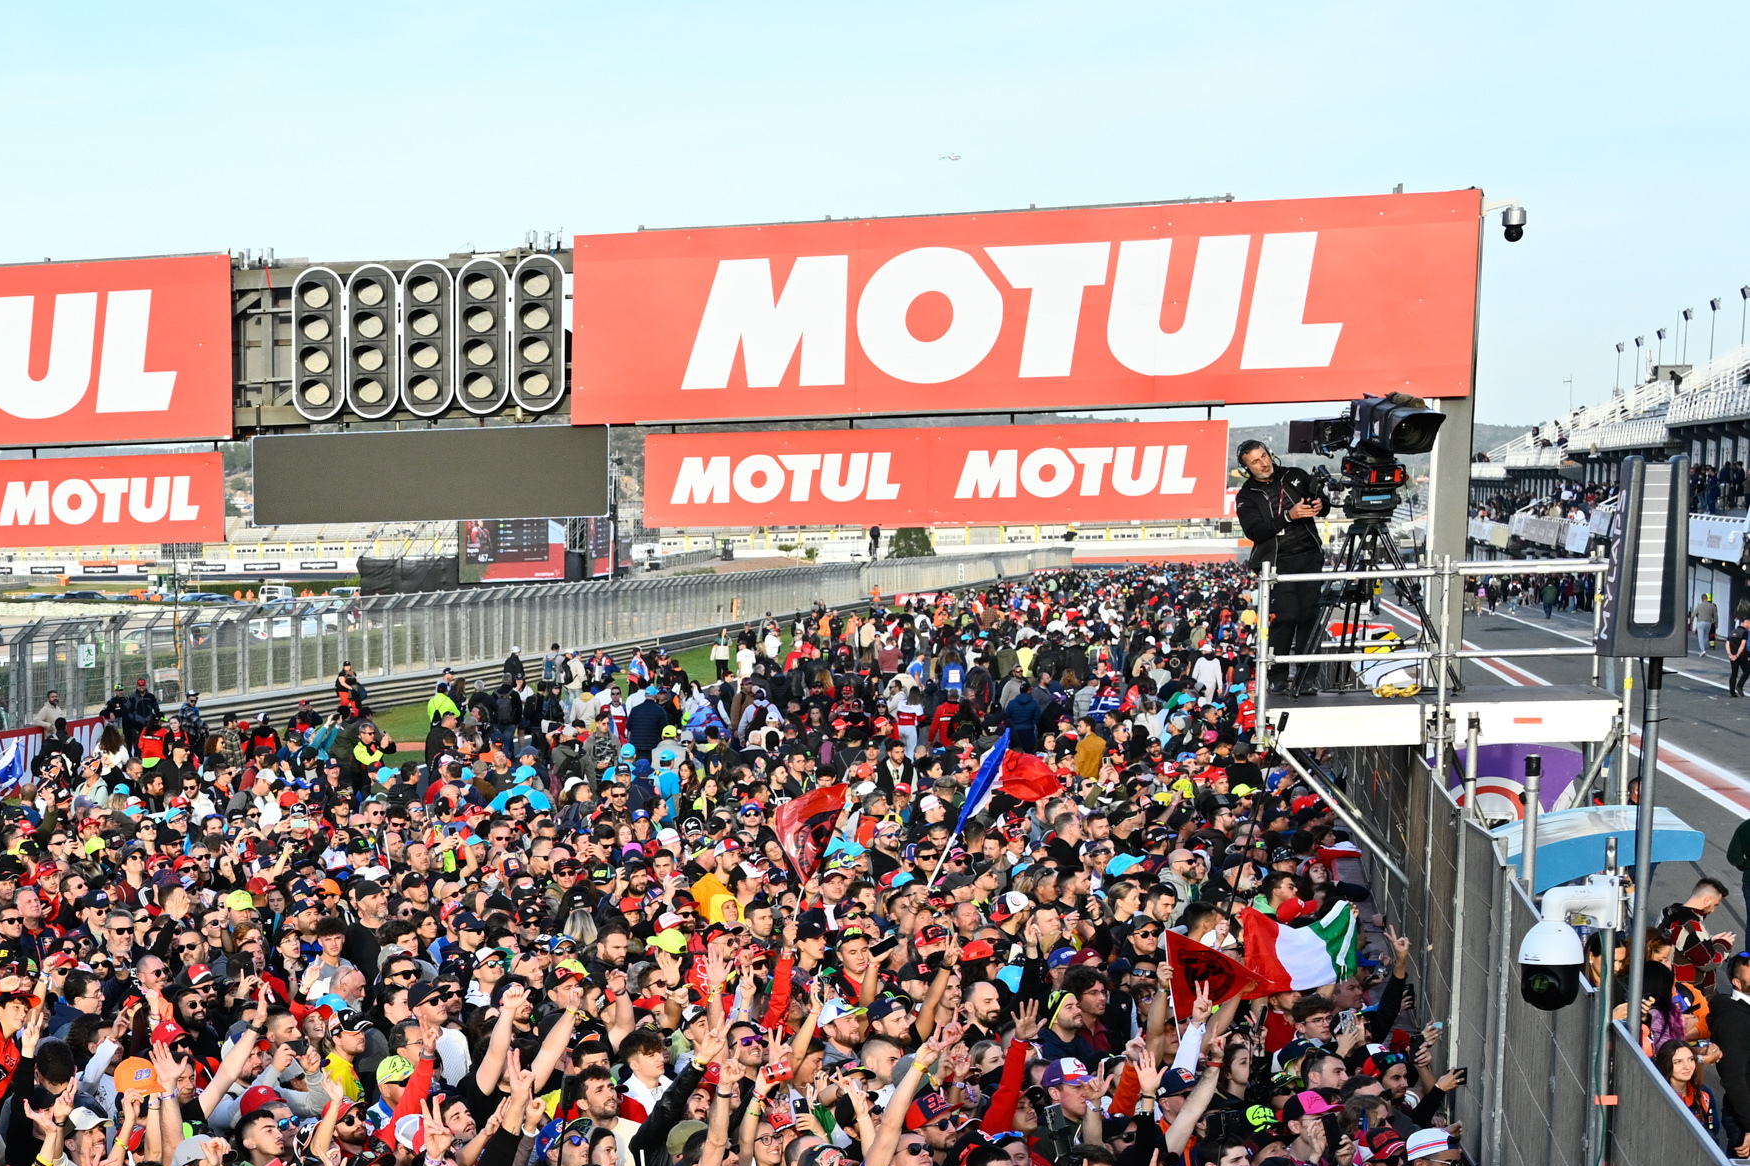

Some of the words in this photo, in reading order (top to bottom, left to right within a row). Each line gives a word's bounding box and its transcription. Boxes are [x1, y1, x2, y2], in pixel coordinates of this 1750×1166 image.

[681, 232, 1343, 389] MOTUL
[671, 453, 900, 504] MOTUL
[954, 445, 1196, 498] MOTUL
[1597, 489, 1626, 643] MYLAPS
[592, 870, 606, 878] 46
[132, 1067, 152, 1081] 89
[1252, 1106, 1275, 1121] 46
